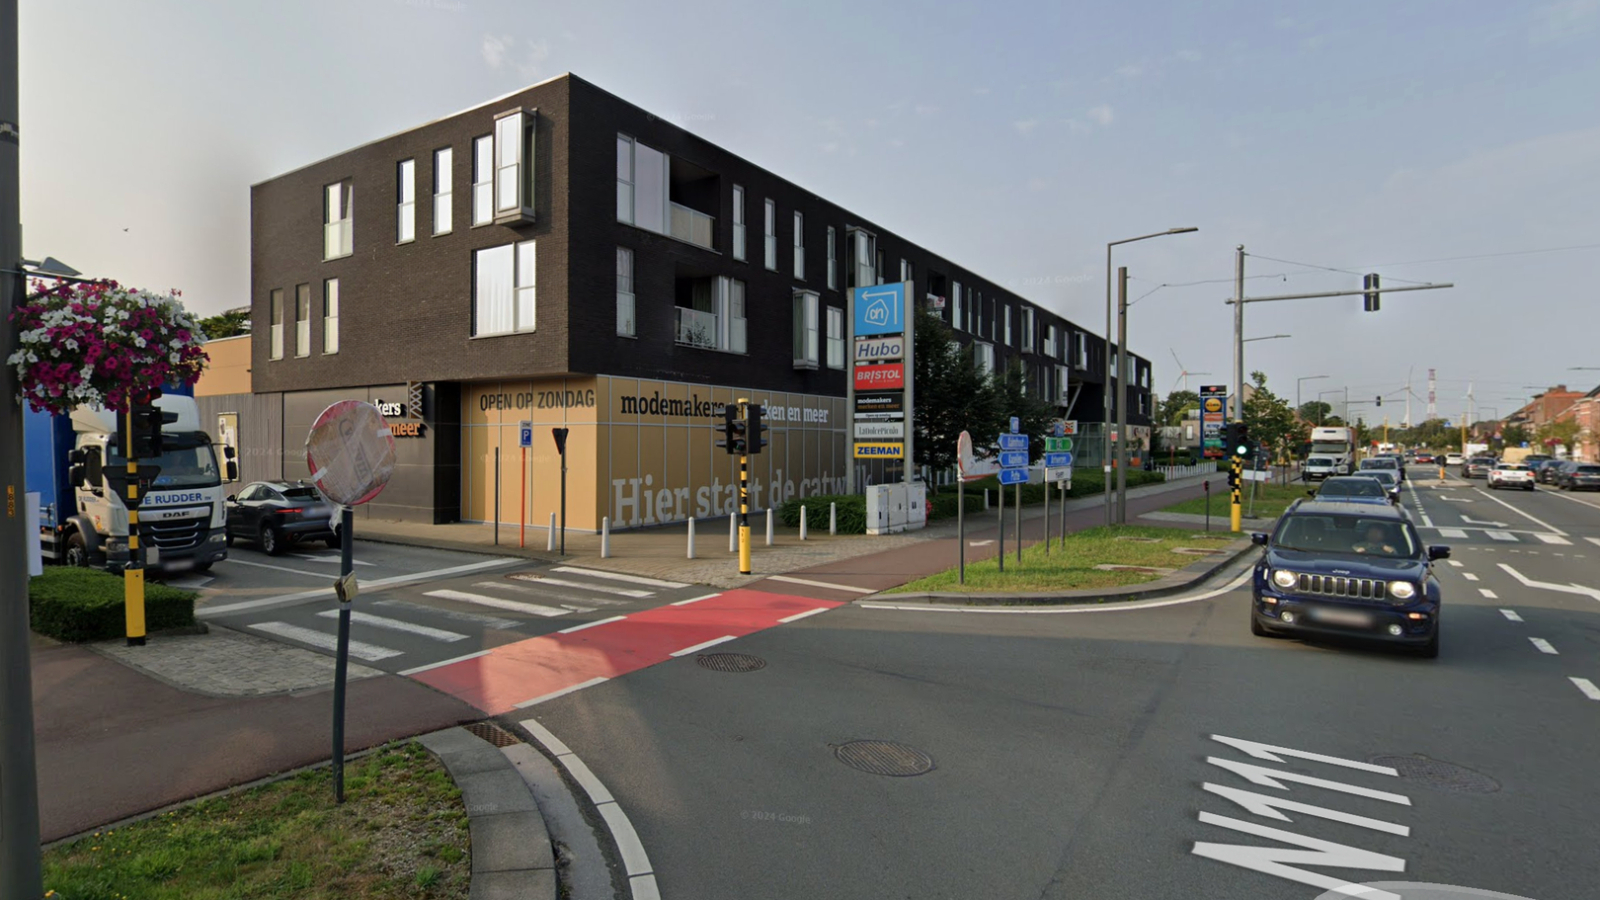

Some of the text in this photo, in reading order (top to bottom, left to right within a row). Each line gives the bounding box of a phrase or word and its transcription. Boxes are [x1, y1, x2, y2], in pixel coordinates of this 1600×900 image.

[858, 342, 900, 357] Hubo
[480, 389, 595, 411] OPEN OP ZONDAG
[787, 405, 801, 421] en
[803, 406, 829, 423] meer
[523, 430, 530, 440] P
[857, 446, 900, 455] ZEEMAN
[155, 493, 202, 504] RUDDER
[612, 474, 690, 527] Hier
[768, 469, 795, 509] de
[799, 465, 873, 500] catwlk
